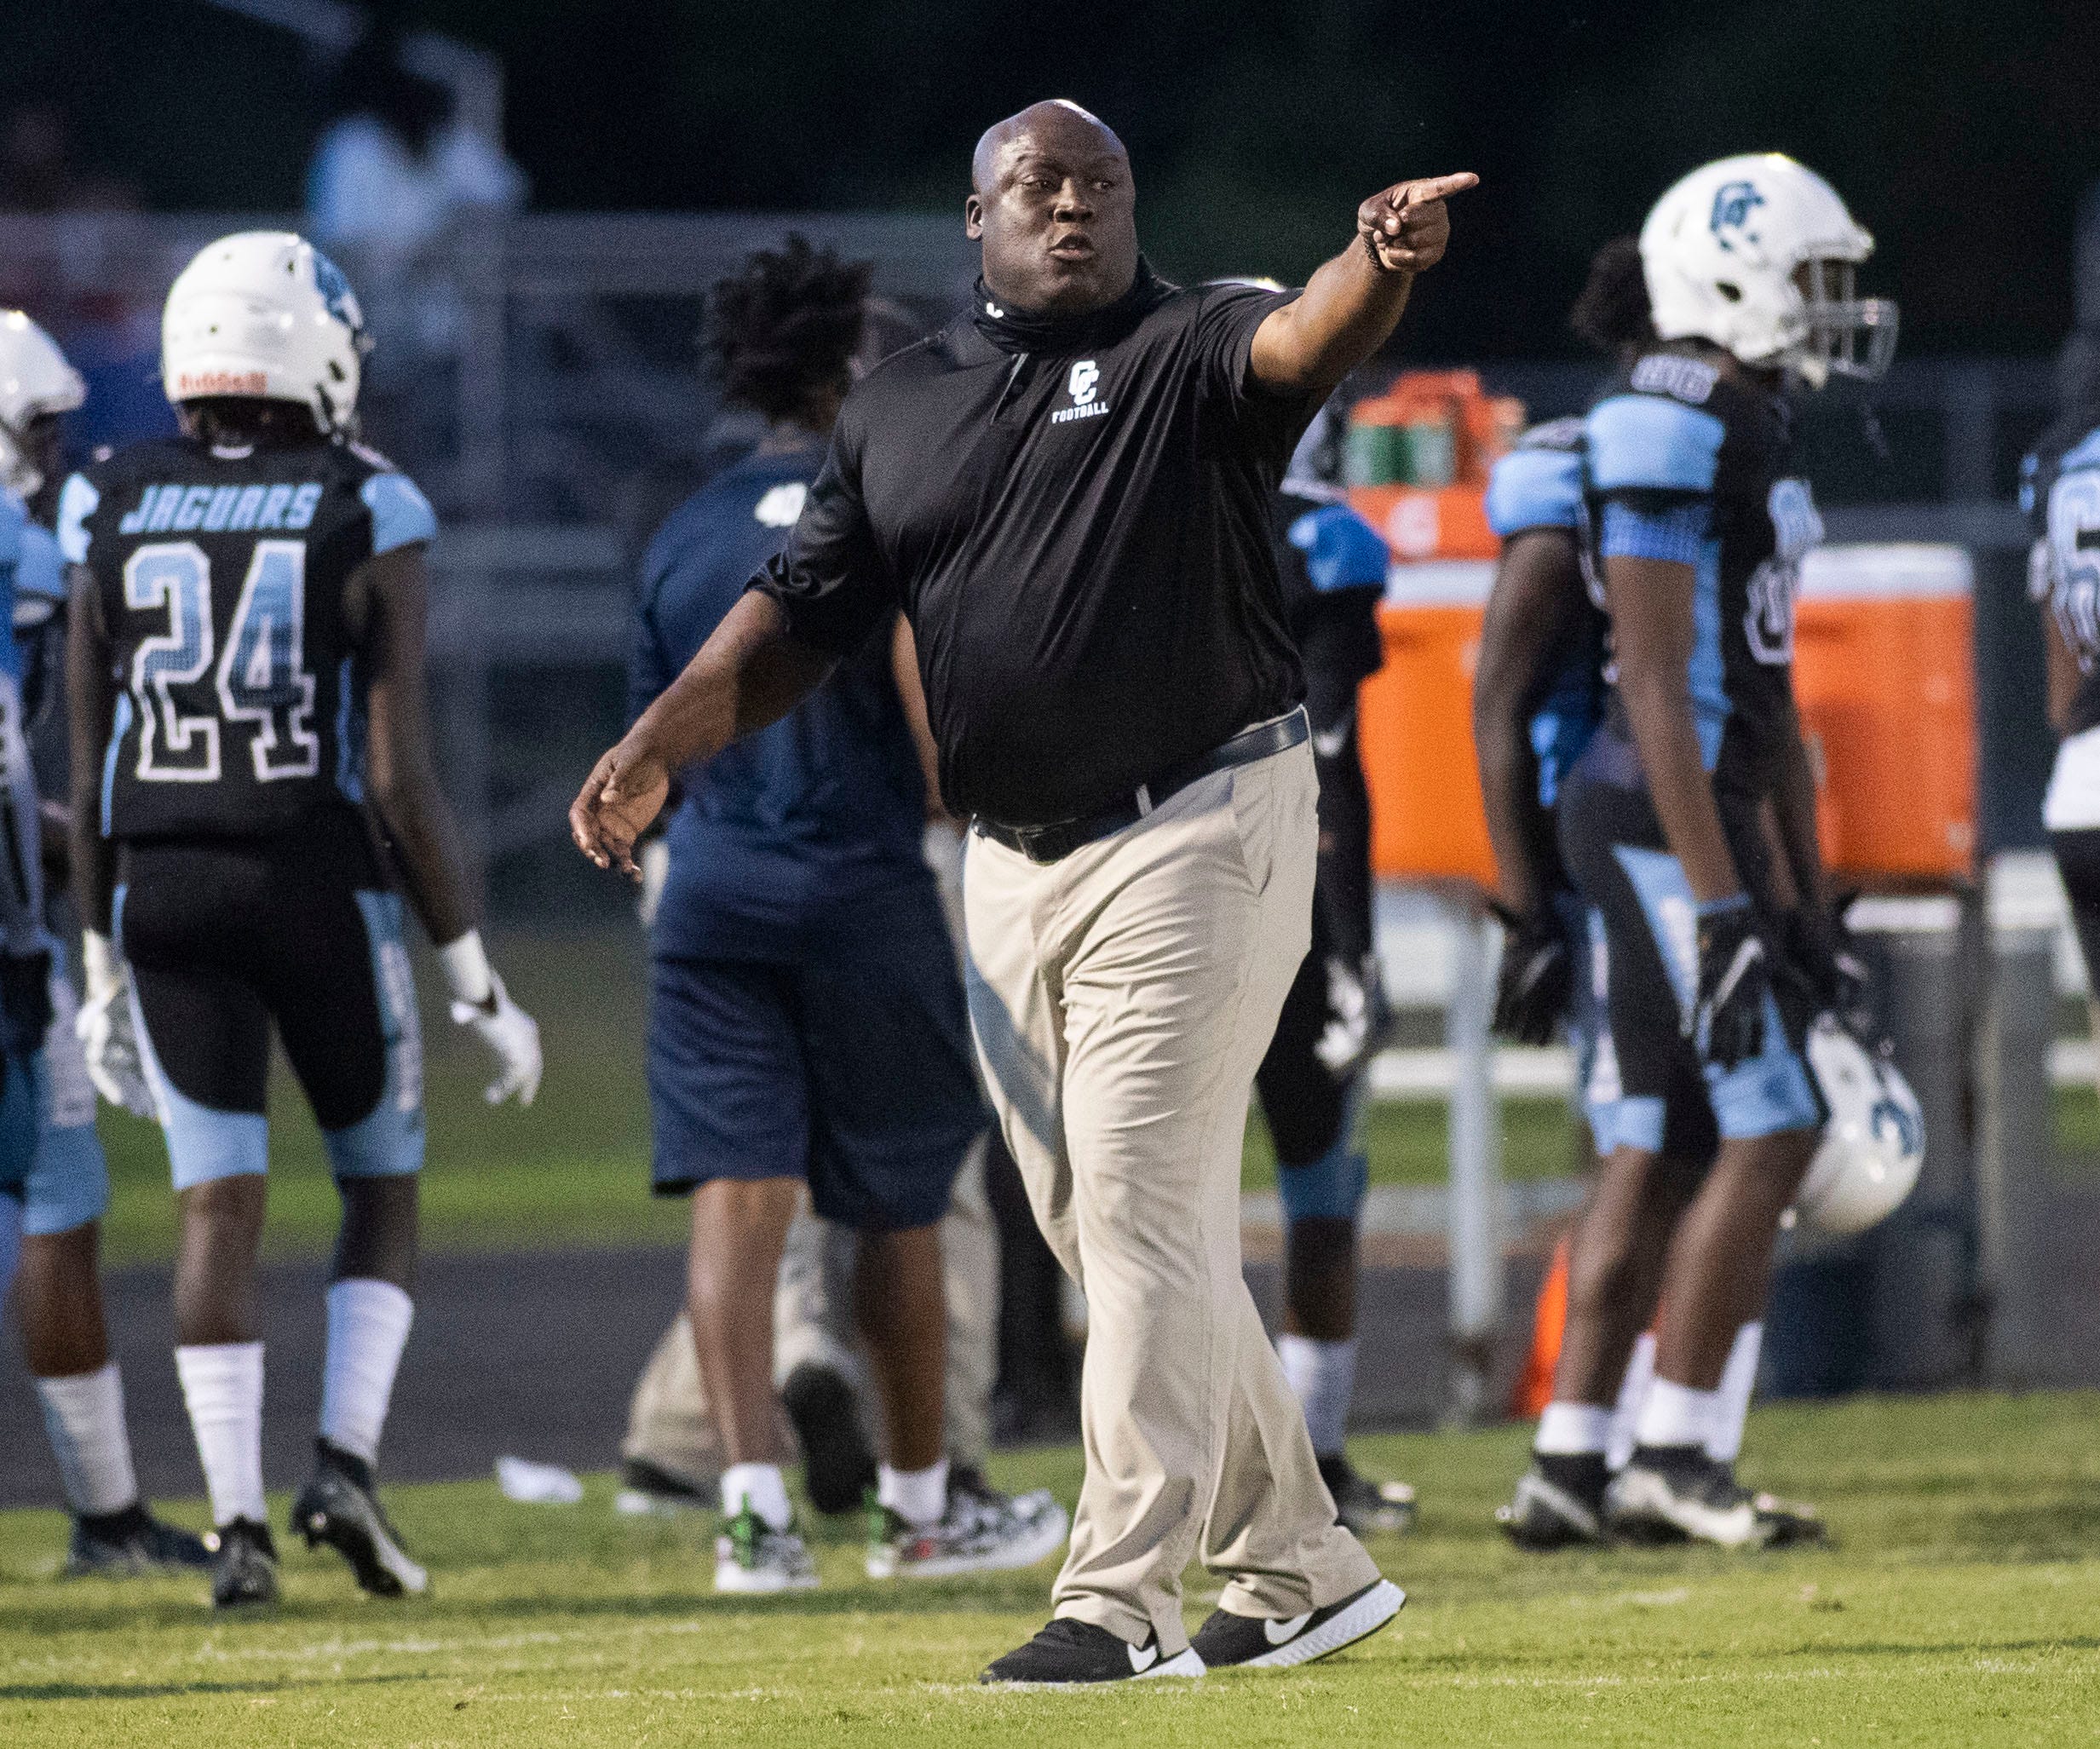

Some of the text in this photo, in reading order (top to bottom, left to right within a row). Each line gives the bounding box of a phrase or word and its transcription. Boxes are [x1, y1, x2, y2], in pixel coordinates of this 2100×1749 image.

[1051, 401, 1109, 424] FOOTBALL
[118, 482, 325, 534] JAGUARS
[124, 538, 321, 782] 24
